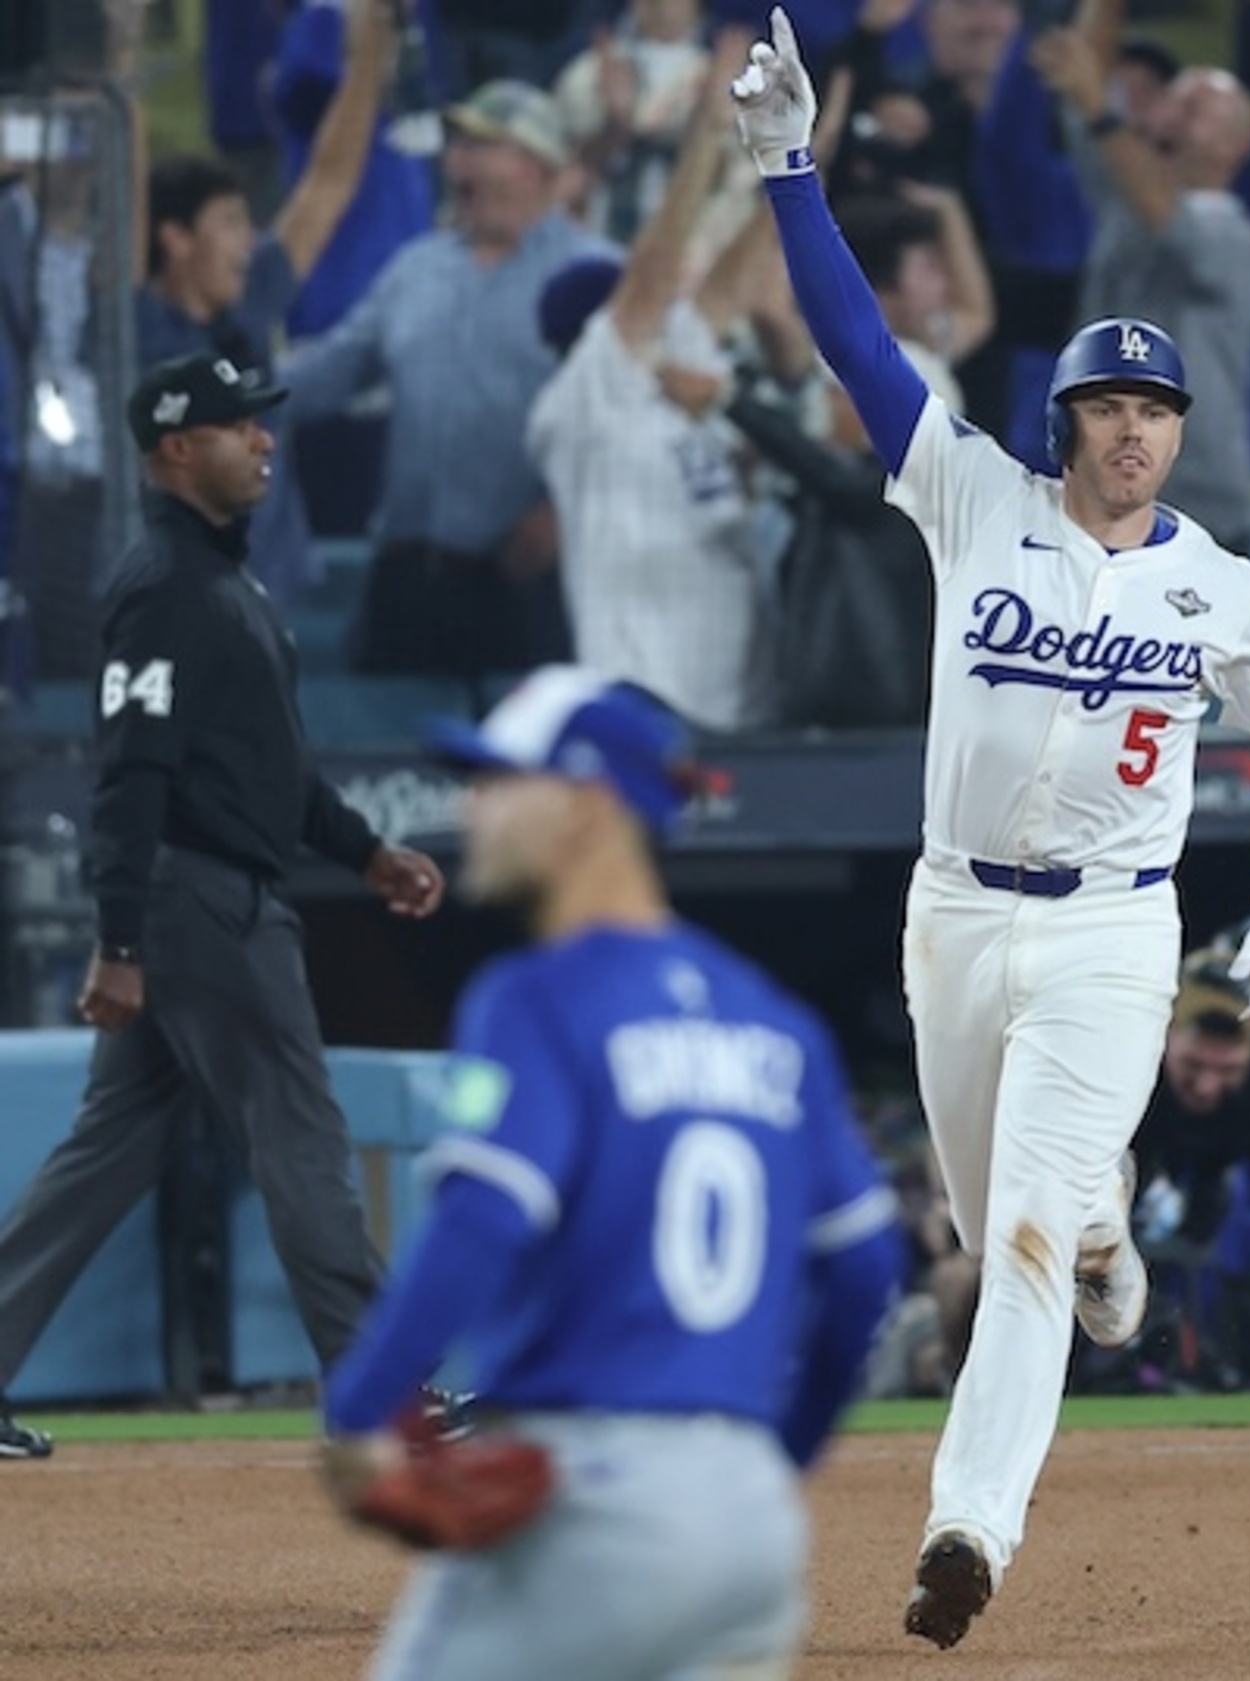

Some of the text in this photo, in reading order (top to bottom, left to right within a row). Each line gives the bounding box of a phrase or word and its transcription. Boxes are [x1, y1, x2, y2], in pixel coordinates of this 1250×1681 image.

[1119, 325, 1151, 362] LA
[964, 587, 1201, 710] Dodgers
[102, 660, 174, 719] 64
[1116, 708, 1169, 787] 5
[654, 1118, 768, 1333] 0
